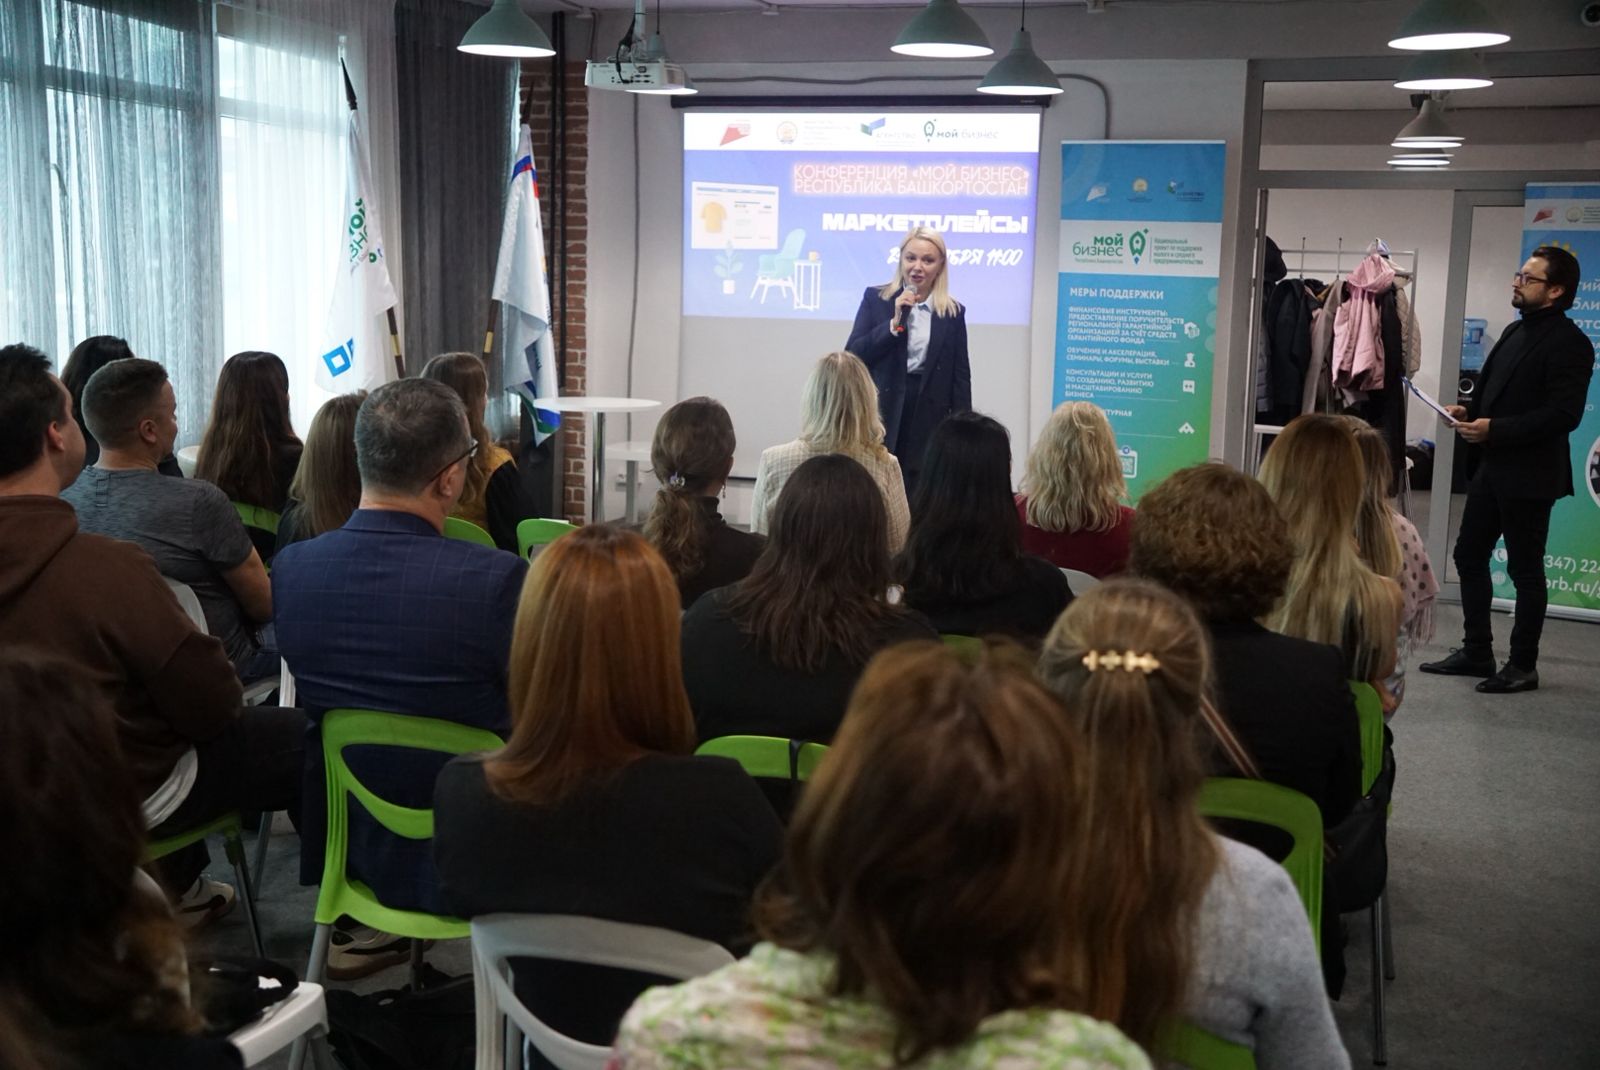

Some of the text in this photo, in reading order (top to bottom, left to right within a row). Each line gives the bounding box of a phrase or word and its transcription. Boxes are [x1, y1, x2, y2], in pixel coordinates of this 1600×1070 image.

[794, 164, 1030, 182] КОНФЕРЕНЦИЯ «МОЙ БИЗНЕС»
[794, 179, 1028, 196] РЕСПУБЛИКА БАШКОРТОСТАН
[821, 209, 1029, 234] МАРКЕТПЛЕЙСЫ
[1072, 241, 1123, 257] бизнес
[1070, 287, 1164, 300] МЕРЫ ПОДДЕРЖКИ
[1068, 306, 1115, 314] ФИНАНСОВЫЕ
[1068, 313, 1127, 322] ПРЕДОСТАВЛЕНИЕ
[1068, 320, 1172, 331] РЕГИОНАЛЬНОЙ ГАРАНТИЙНОЙ
[1067, 327, 1120, 336] ОРГАНИЗАЦИЕЙ
[1067, 334, 1145, 345] ГАРАНТИЙНОГО ФОНДА
[1067, 347, 1100, 355] ОБУЧЕНИЕ
[1135, 358, 1169, 366] ВЫСТАВКИ
[1066, 369, 1119, 378] КОНСУЛЬТАЦИИ
[1127, 372, 1152, 380] УСЛУГИ
[1071, 384, 1142, 394] МАСШТАБИРОВАНИЮ
